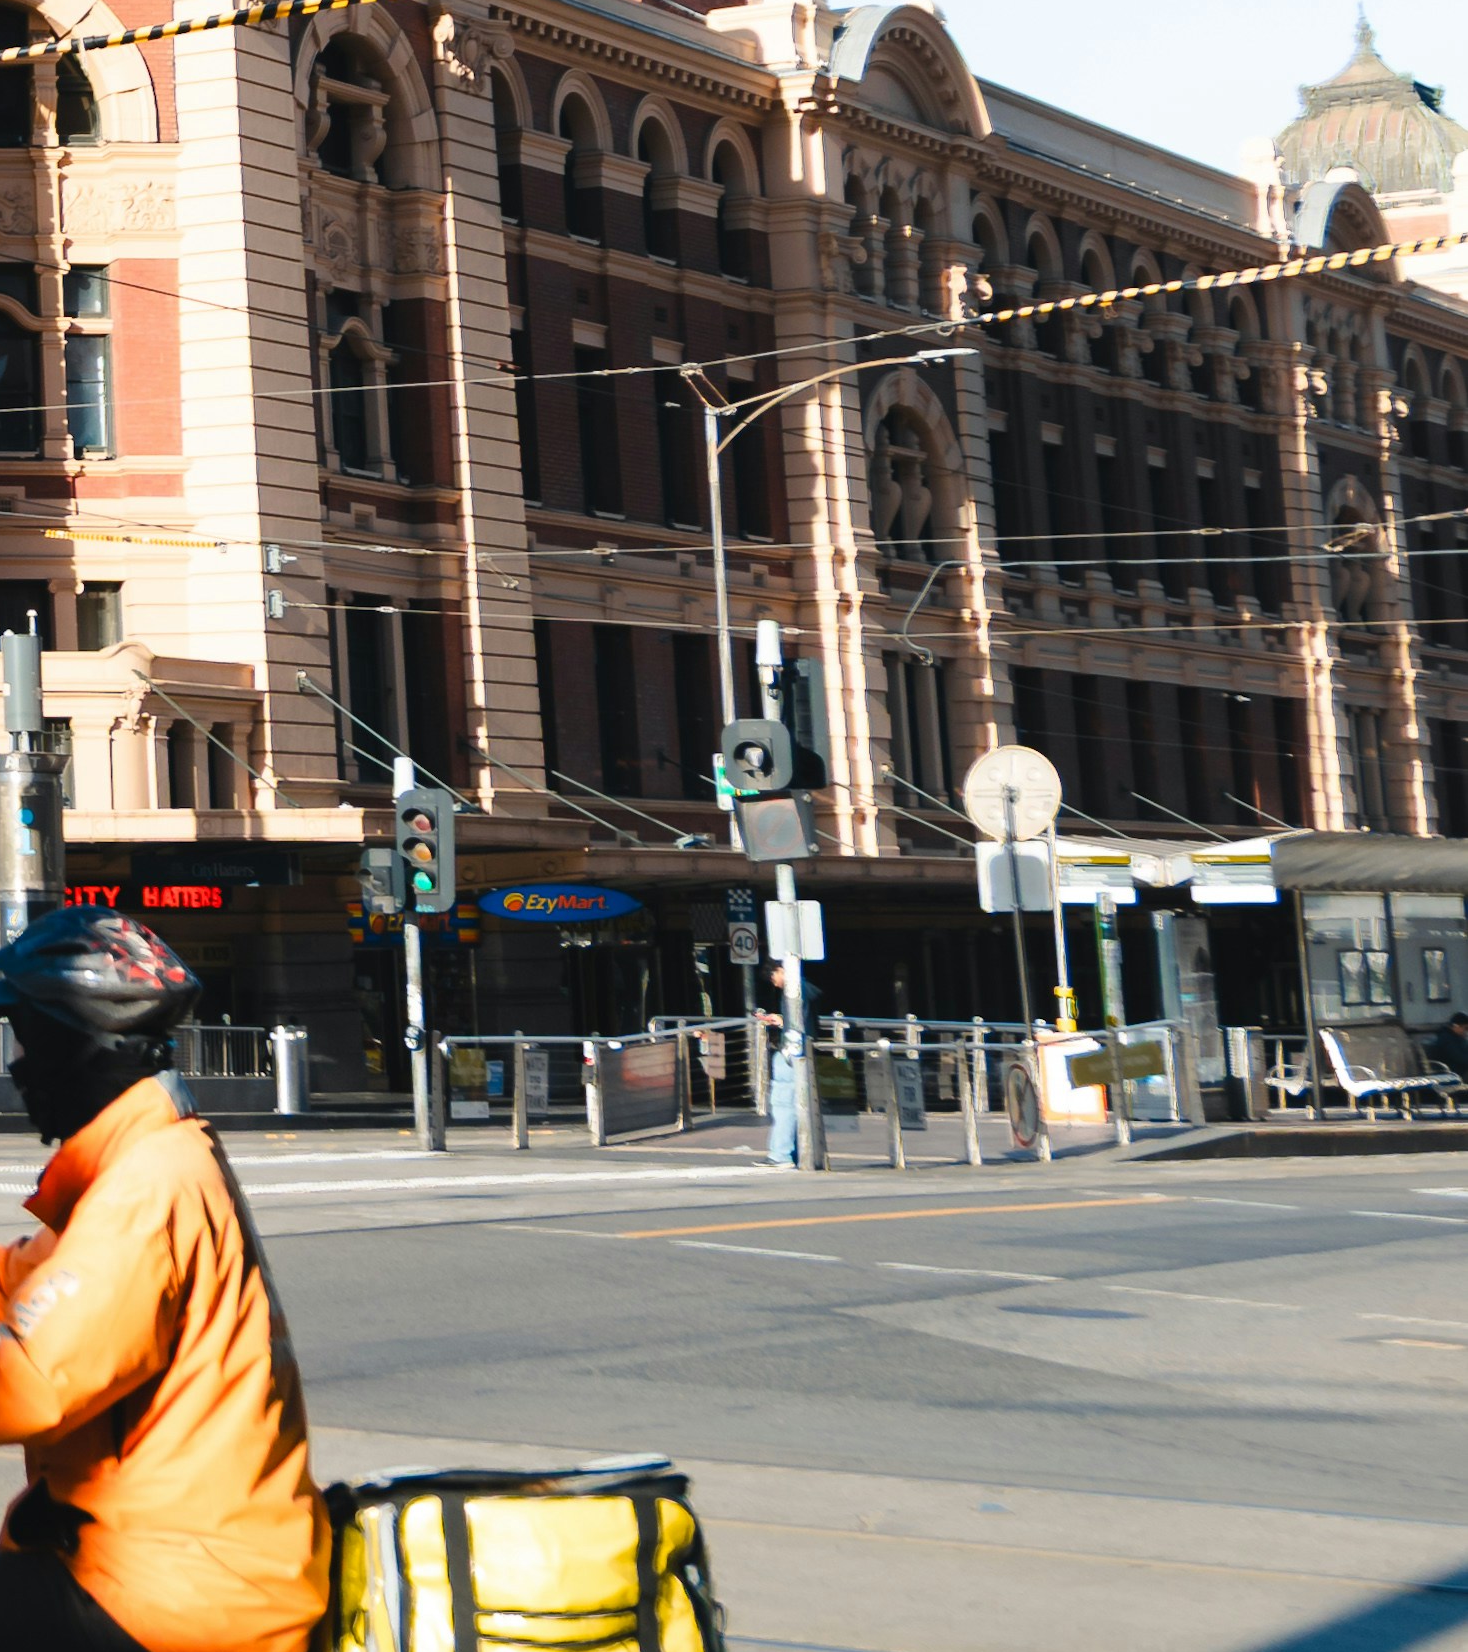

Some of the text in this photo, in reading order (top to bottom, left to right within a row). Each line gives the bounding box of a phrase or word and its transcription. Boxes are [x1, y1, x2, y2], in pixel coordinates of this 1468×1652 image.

[142, 885, 223, 909] HATTERS
[525, 894, 607, 914] EzyMart
[734, 936, 755, 952] 40
